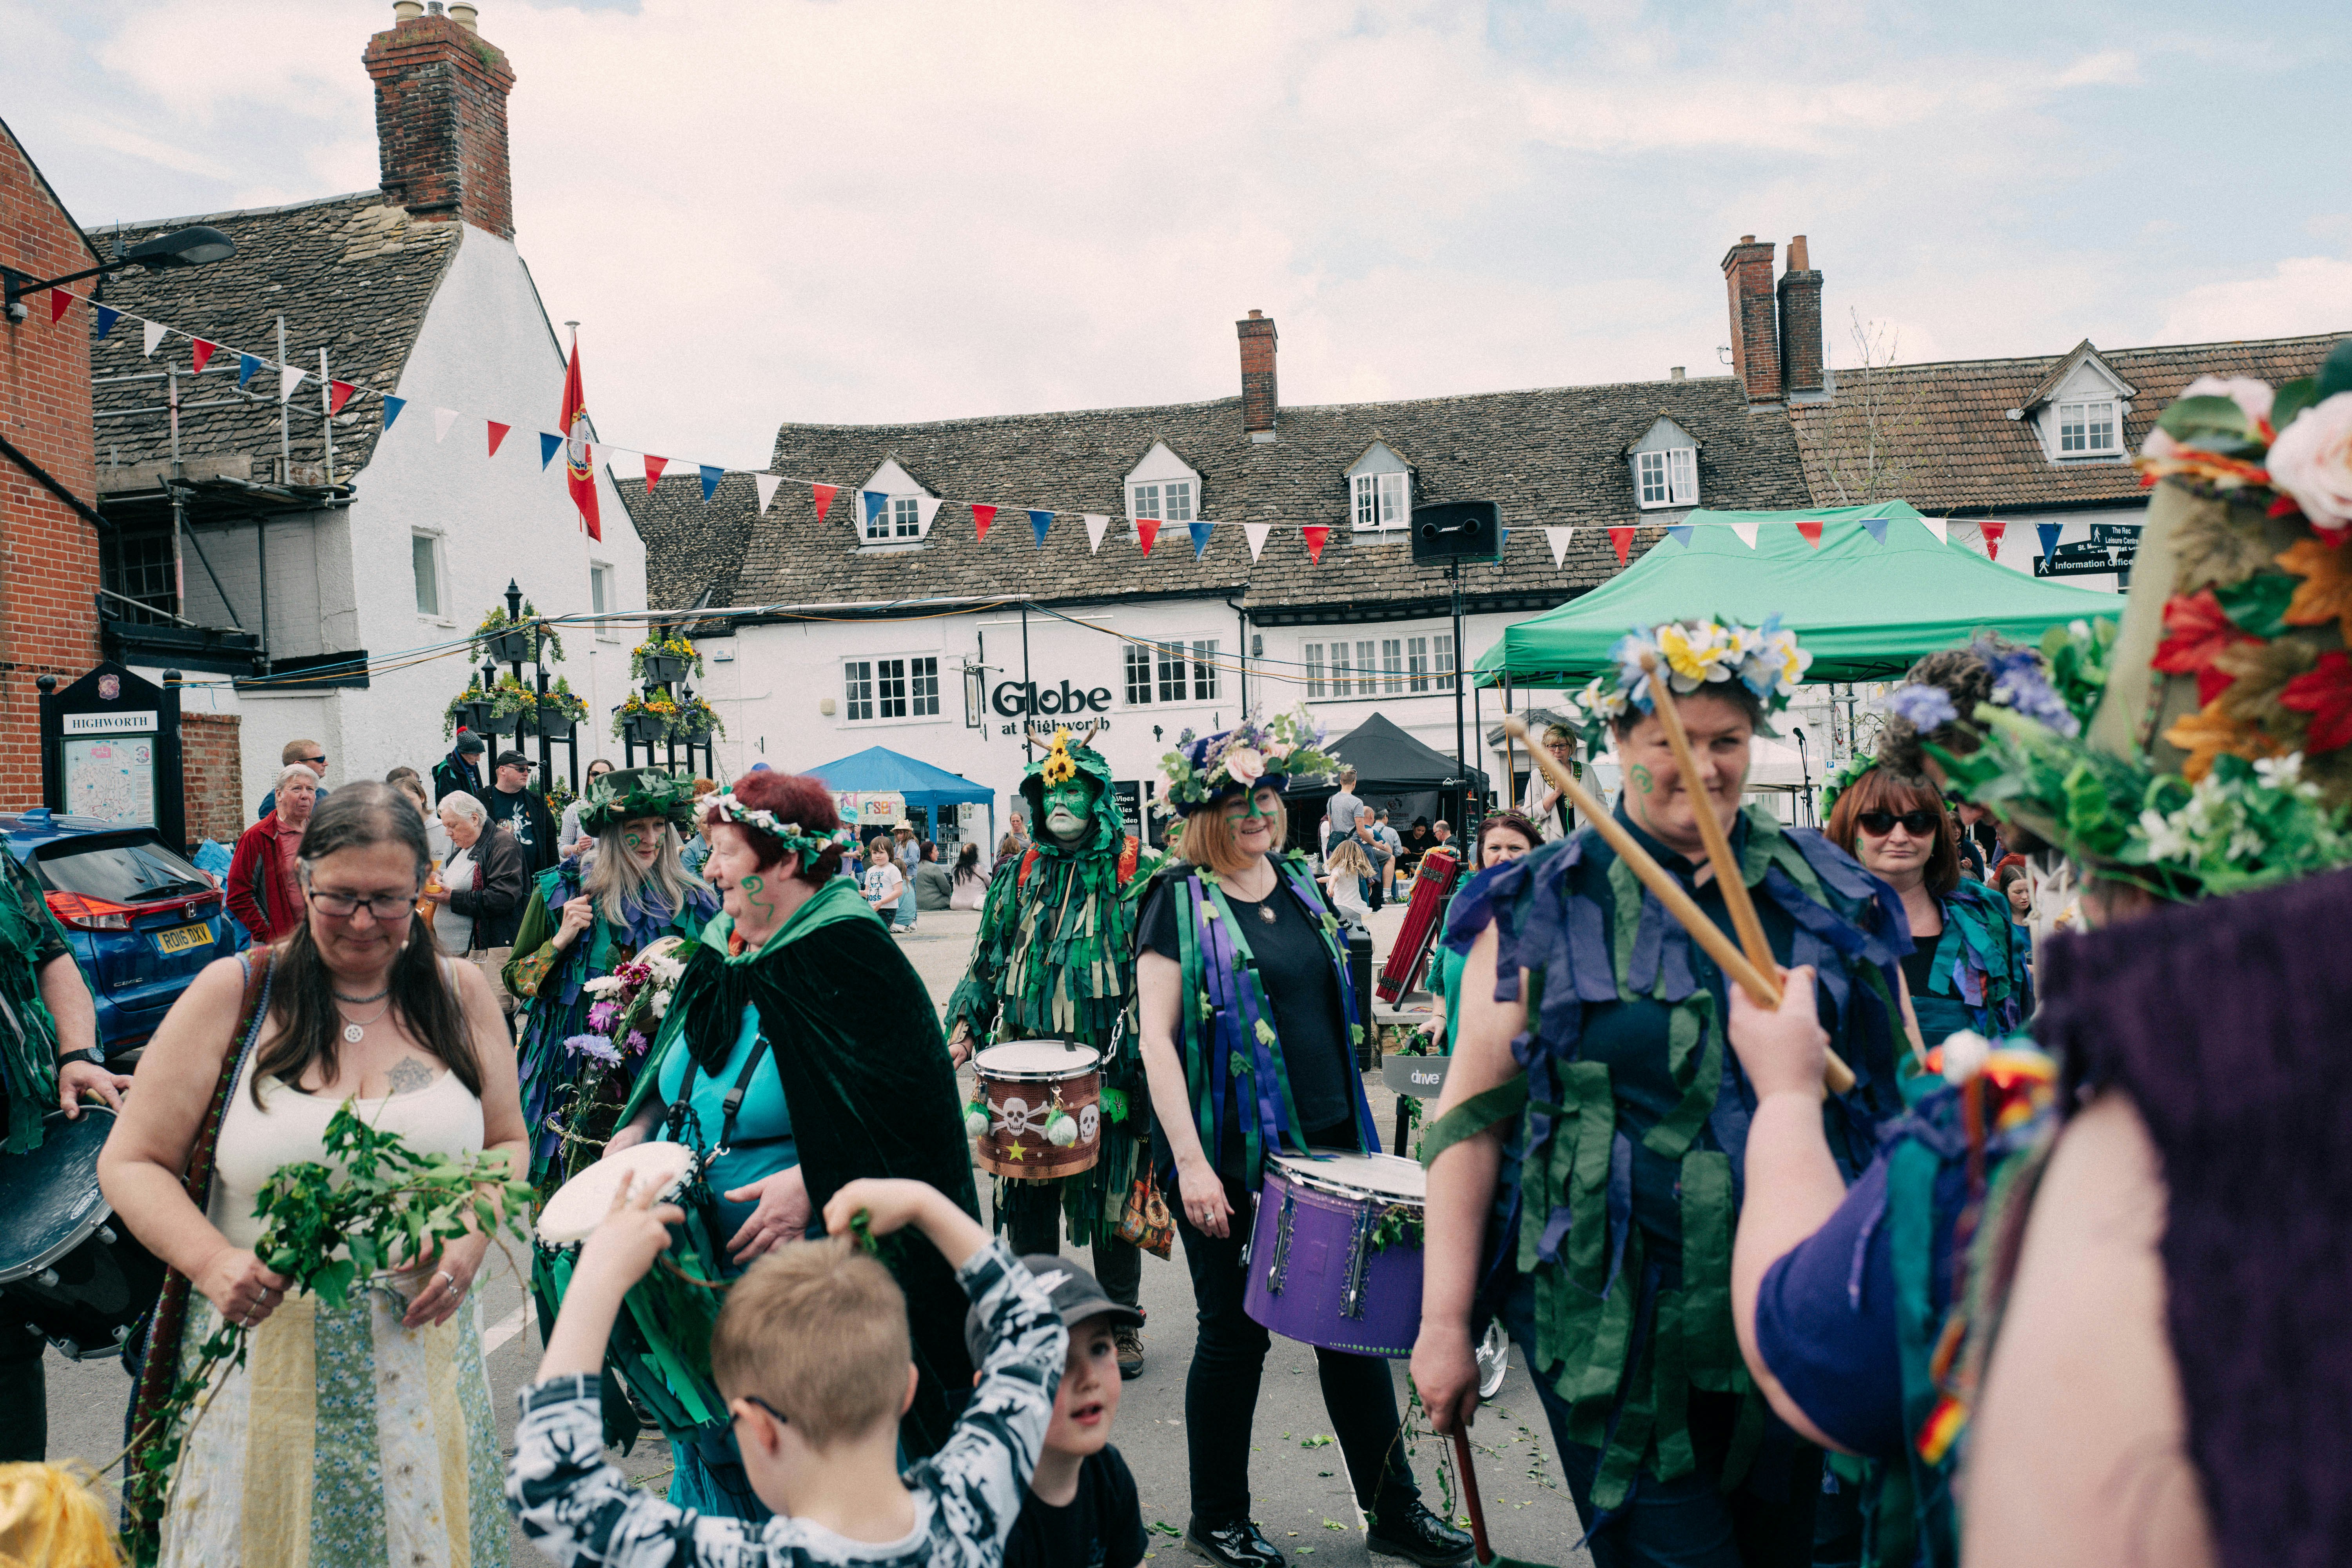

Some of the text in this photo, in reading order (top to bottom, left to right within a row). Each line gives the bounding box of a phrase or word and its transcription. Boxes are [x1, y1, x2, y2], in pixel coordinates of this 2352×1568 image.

[2055, 560, 2105, 569] Information
[992, 679, 1112, 717] Globe
[73, 717, 147, 728] HIGHWORTH
[1002, 722, 1017, 734] at
[187, 926, 208, 942] DXV
[1411, 1070, 1439, 1085] drive
